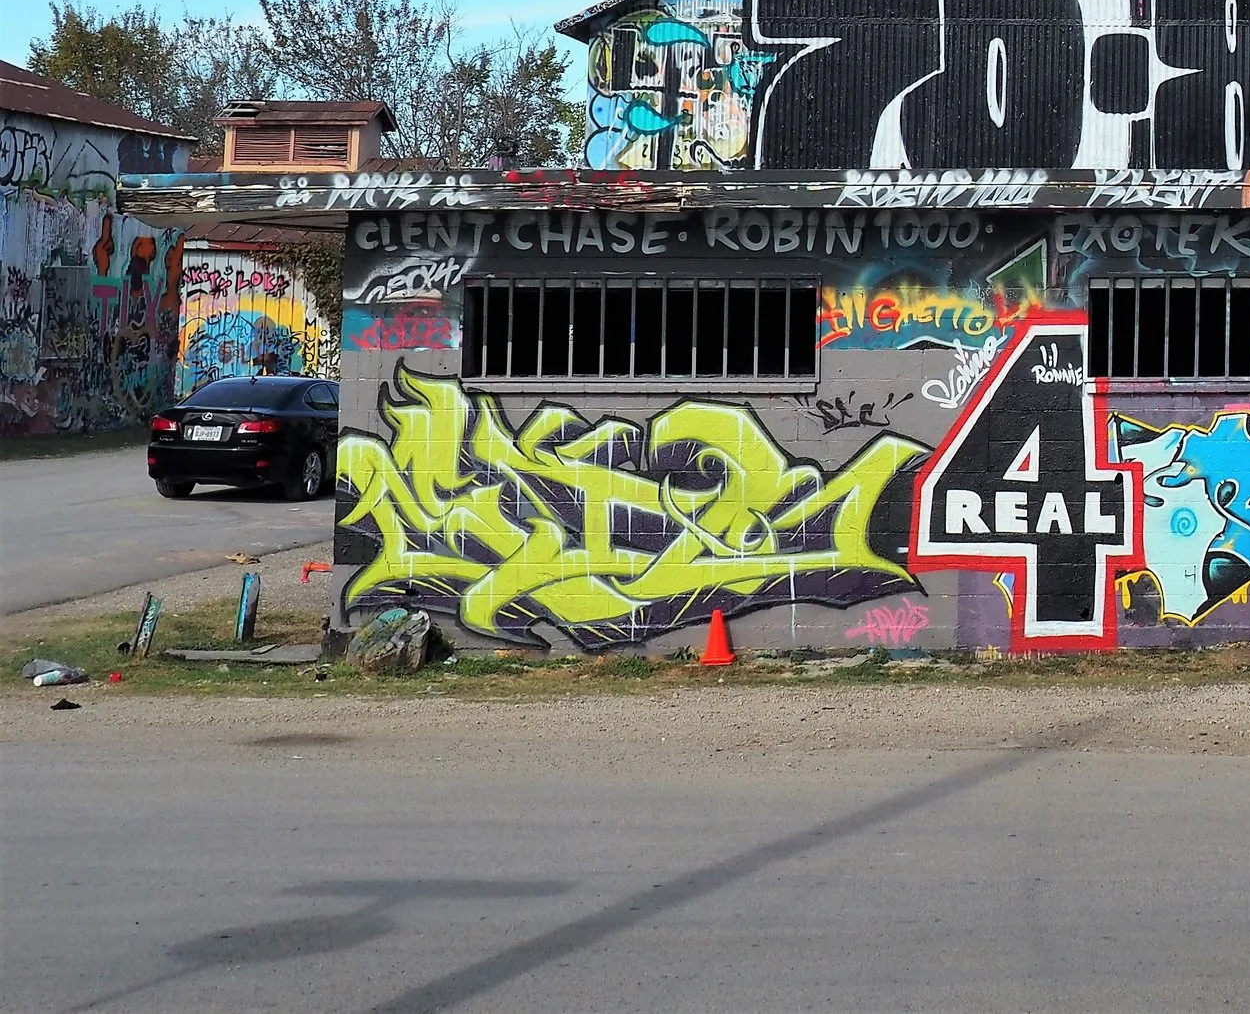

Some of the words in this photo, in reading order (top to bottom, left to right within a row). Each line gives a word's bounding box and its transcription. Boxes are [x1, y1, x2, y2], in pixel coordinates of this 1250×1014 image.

[705, 211, 867, 254] ROBIN
[875, 212, 982, 250] 1000
[911, 316, 1143, 646] 4
[945, 489, 1116, 534] REAL
